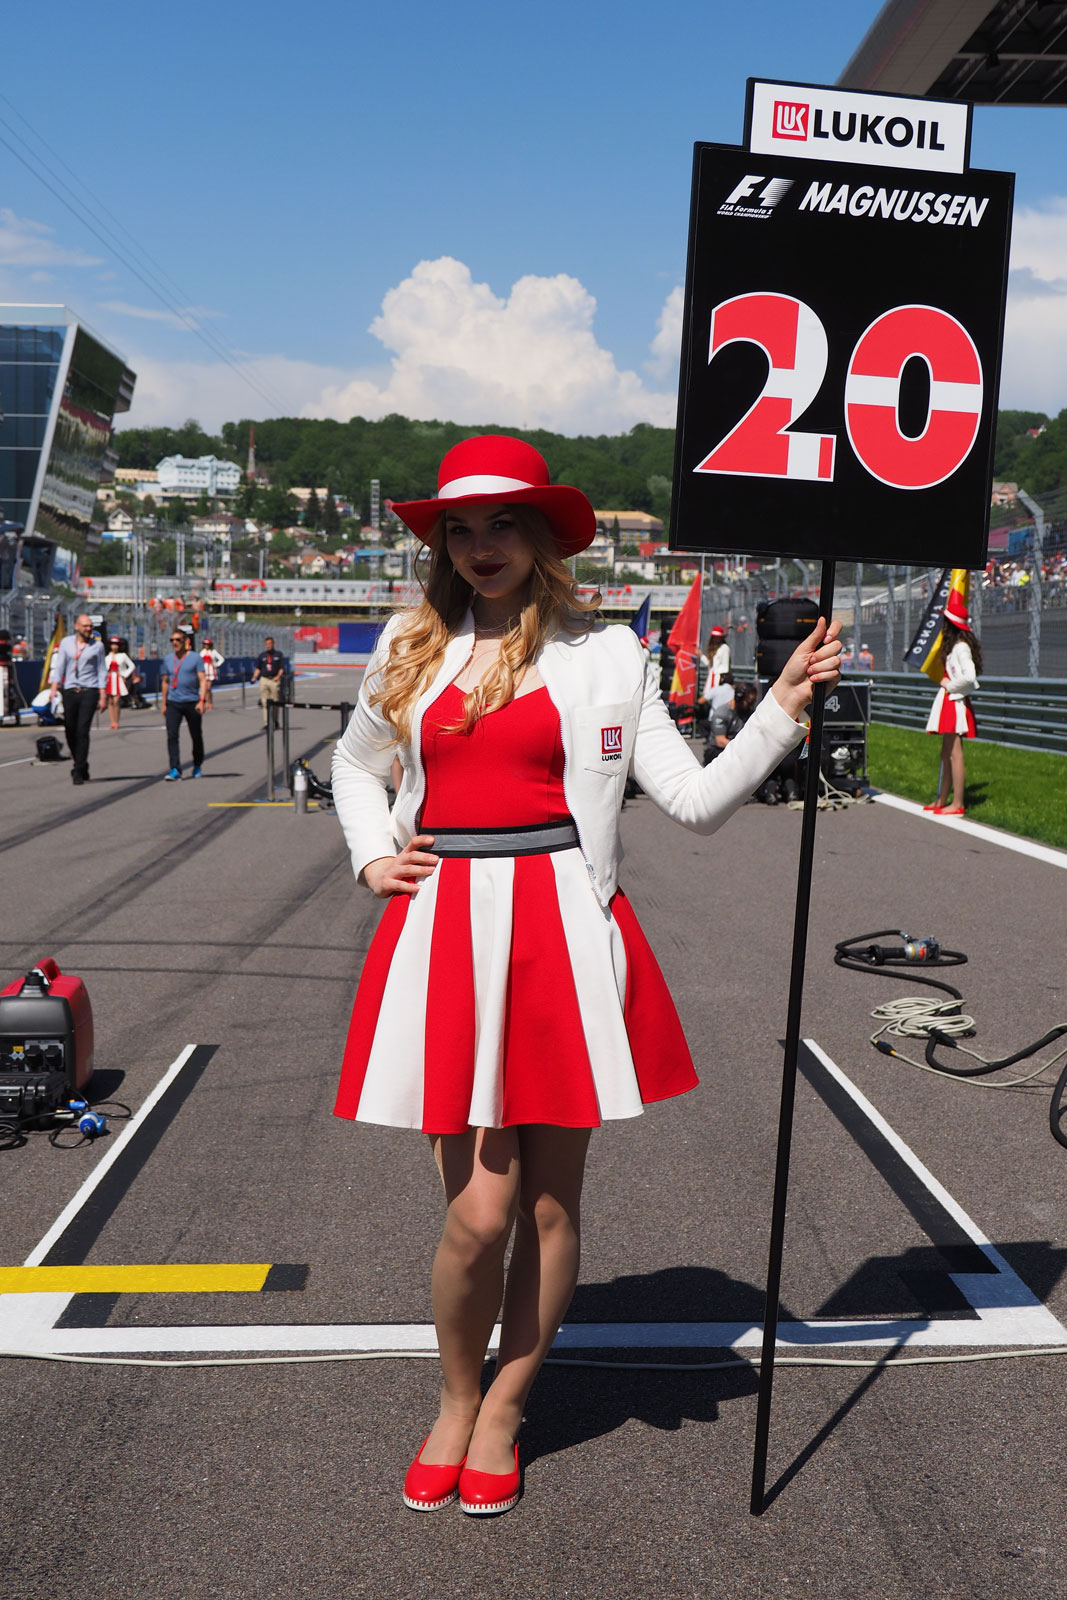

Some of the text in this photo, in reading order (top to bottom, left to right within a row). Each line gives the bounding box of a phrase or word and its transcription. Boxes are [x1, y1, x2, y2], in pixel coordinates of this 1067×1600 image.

[813, 108, 945, 151] LUKOIL
[724, 175, 795, 207] F1
[734, 205, 767, 214] Formula
[798, 181, 989, 227] MAGNUSSEN
[692, 291, 984, 491] 20
